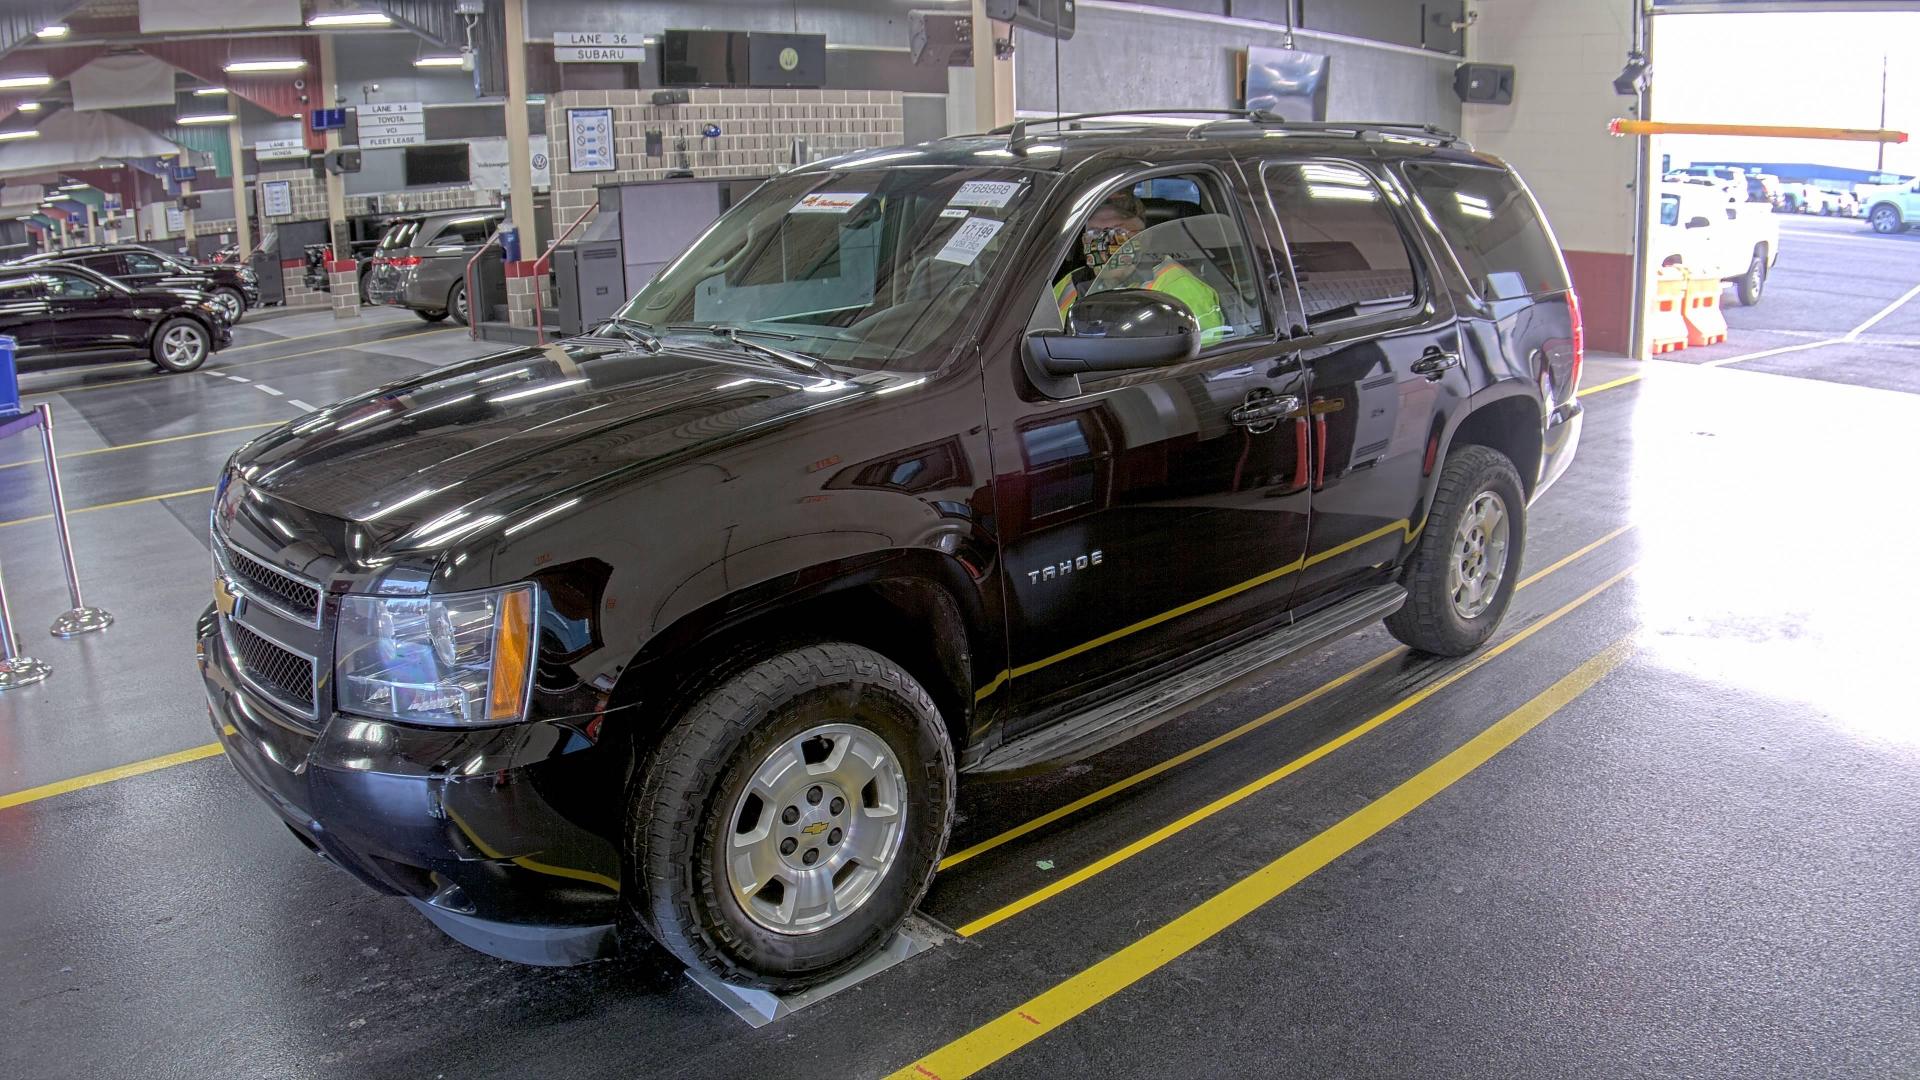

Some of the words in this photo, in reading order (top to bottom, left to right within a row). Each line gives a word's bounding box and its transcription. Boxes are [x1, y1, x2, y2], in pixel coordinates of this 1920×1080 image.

[571, 34, 602, 44] LANE
[613, 34, 628, 44] 36
[578, 49, 624, 59] SUBARU
[372, 104, 392, 113] LANE
[397, 104, 407, 112] 34
[377, 115, 405, 124] TOYOTA
[370, 137, 391, 145] FLEET
[392, 136, 415, 145] LEASE
[1027, 550, 1103, 586] TAHOE
